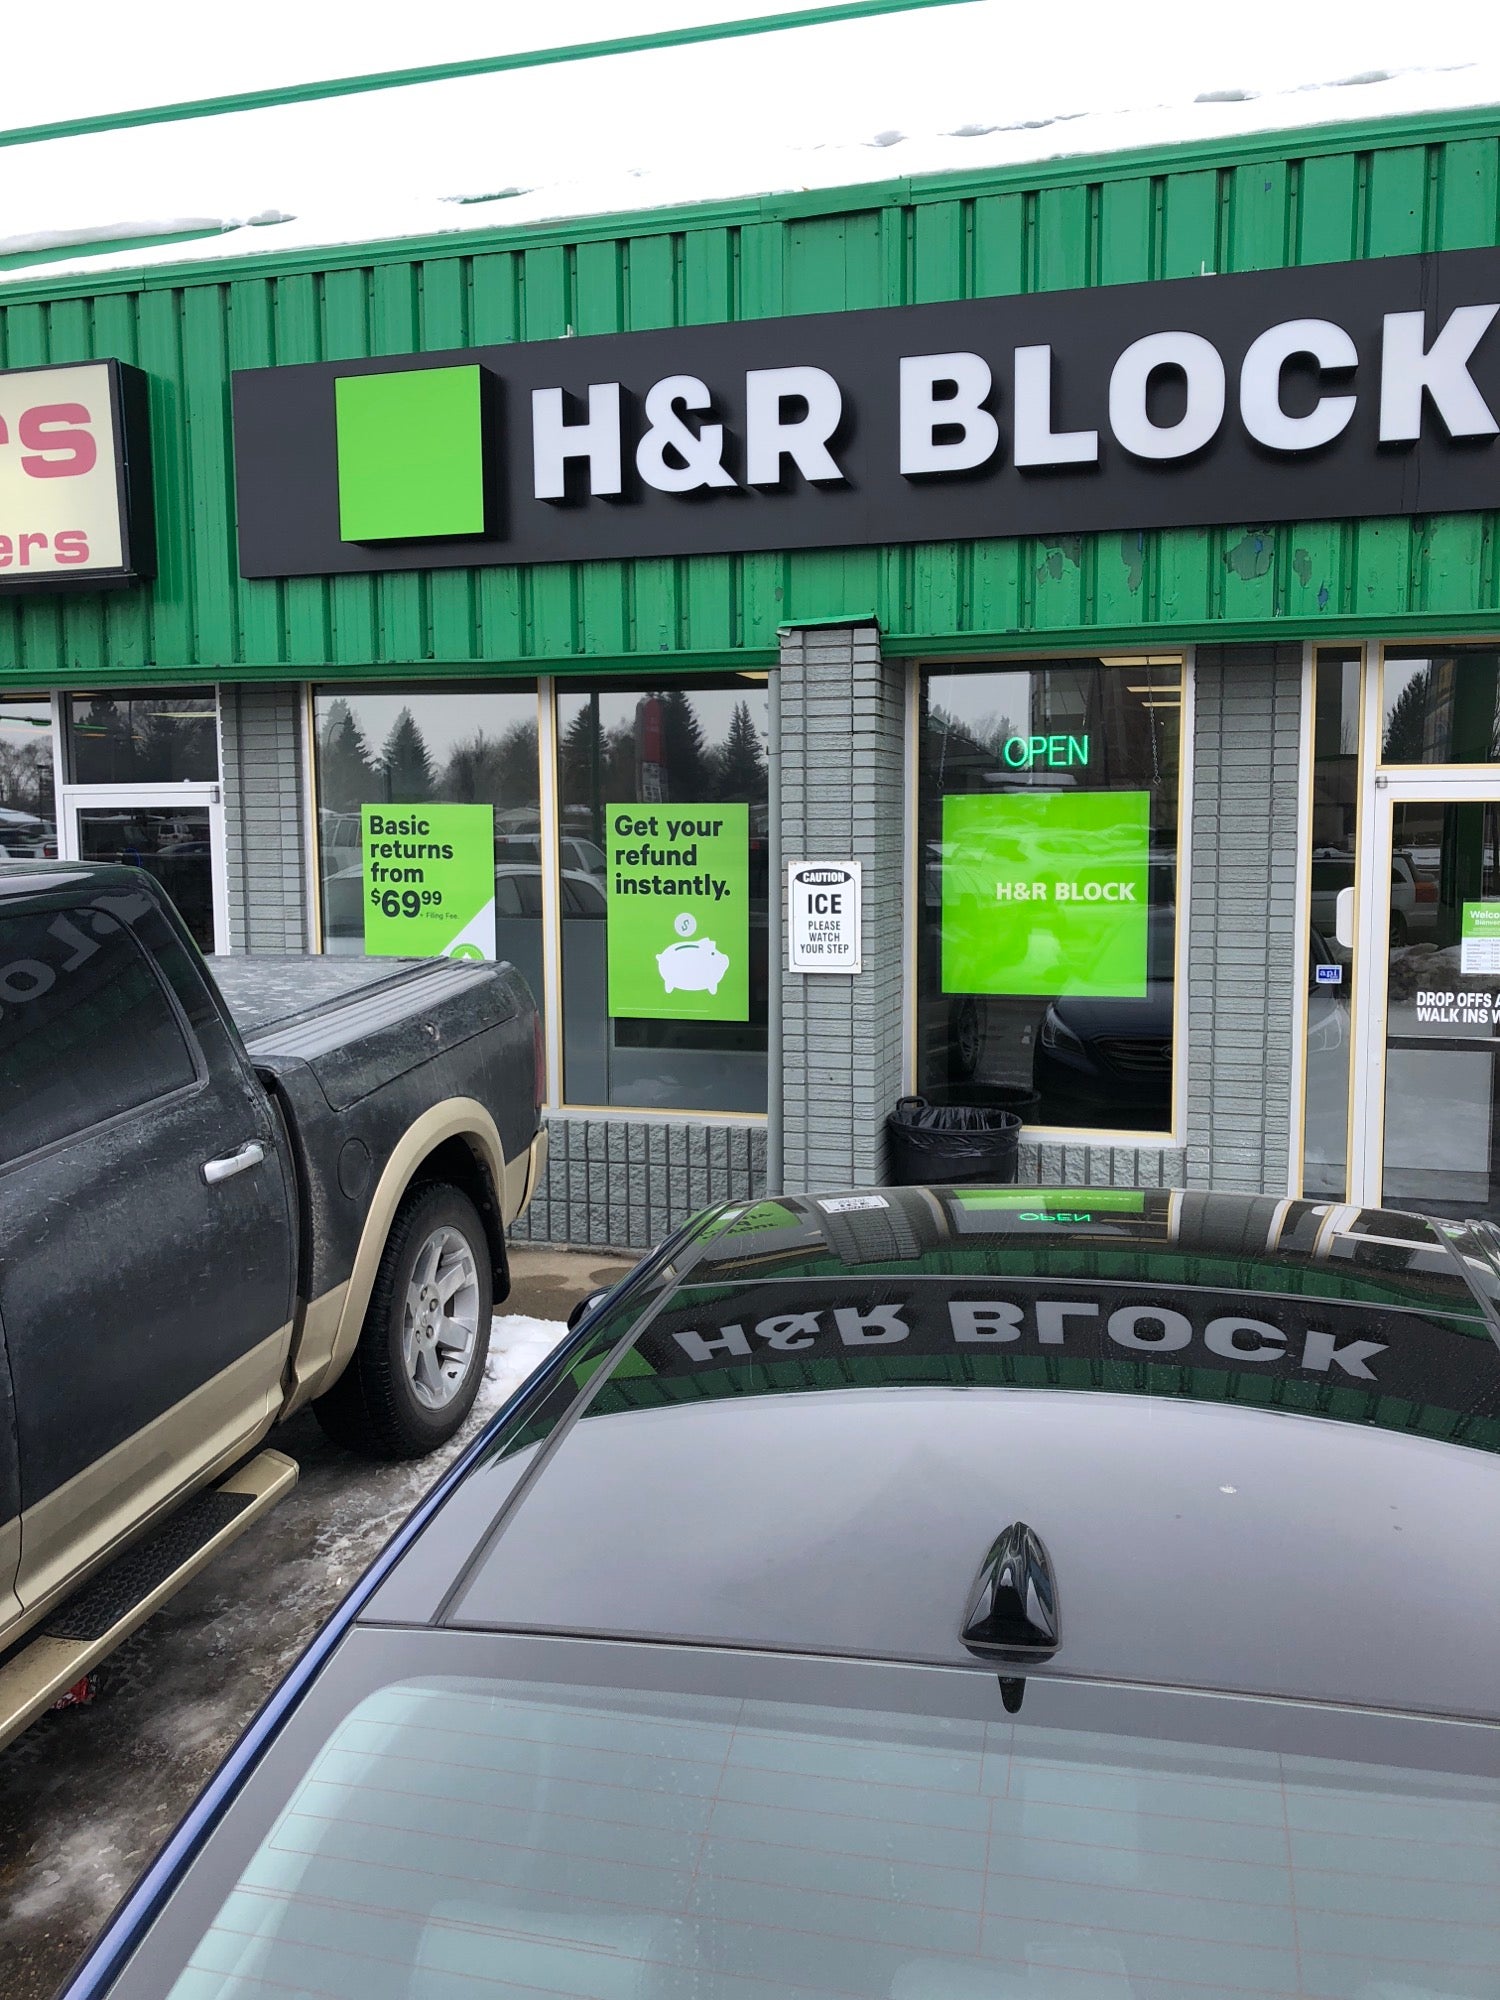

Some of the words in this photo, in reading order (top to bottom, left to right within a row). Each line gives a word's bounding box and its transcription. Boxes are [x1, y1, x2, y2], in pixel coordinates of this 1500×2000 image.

[531, 366, 844, 499] H&R
[899, 303, 1500, 475] BLOCK
[1003, 734, 1089, 768] OPEN
[369, 814, 430, 836] Basic
[614, 814, 659, 837] Get
[666, 819, 724, 842] your
[370, 840, 454, 860] returns
[615, 843, 698, 867] refund
[370, 861, 424, 883] from
[802, 871, 845, 884] CAUTION
[615, 872, 731, 902] instantly.
[996, 882, 1047, 901] H&R
[1054, 882, 1137, 902] BLOCK
[807, 893, 842, 915] ICE
[807, 920, 841, 931] PLEASE
[808, 932, 841, 943] WATCH
[800, 943, 824, 954] YOUR
[827, 943, 850, 954] STEP
[1416, 991, 1455, 1007] DROP
[1456, 992, 1492, 1008] OFFS
[1416, 1007, 1460, 1023] WALK
[1462, 1008, 1489, 1024] INS
